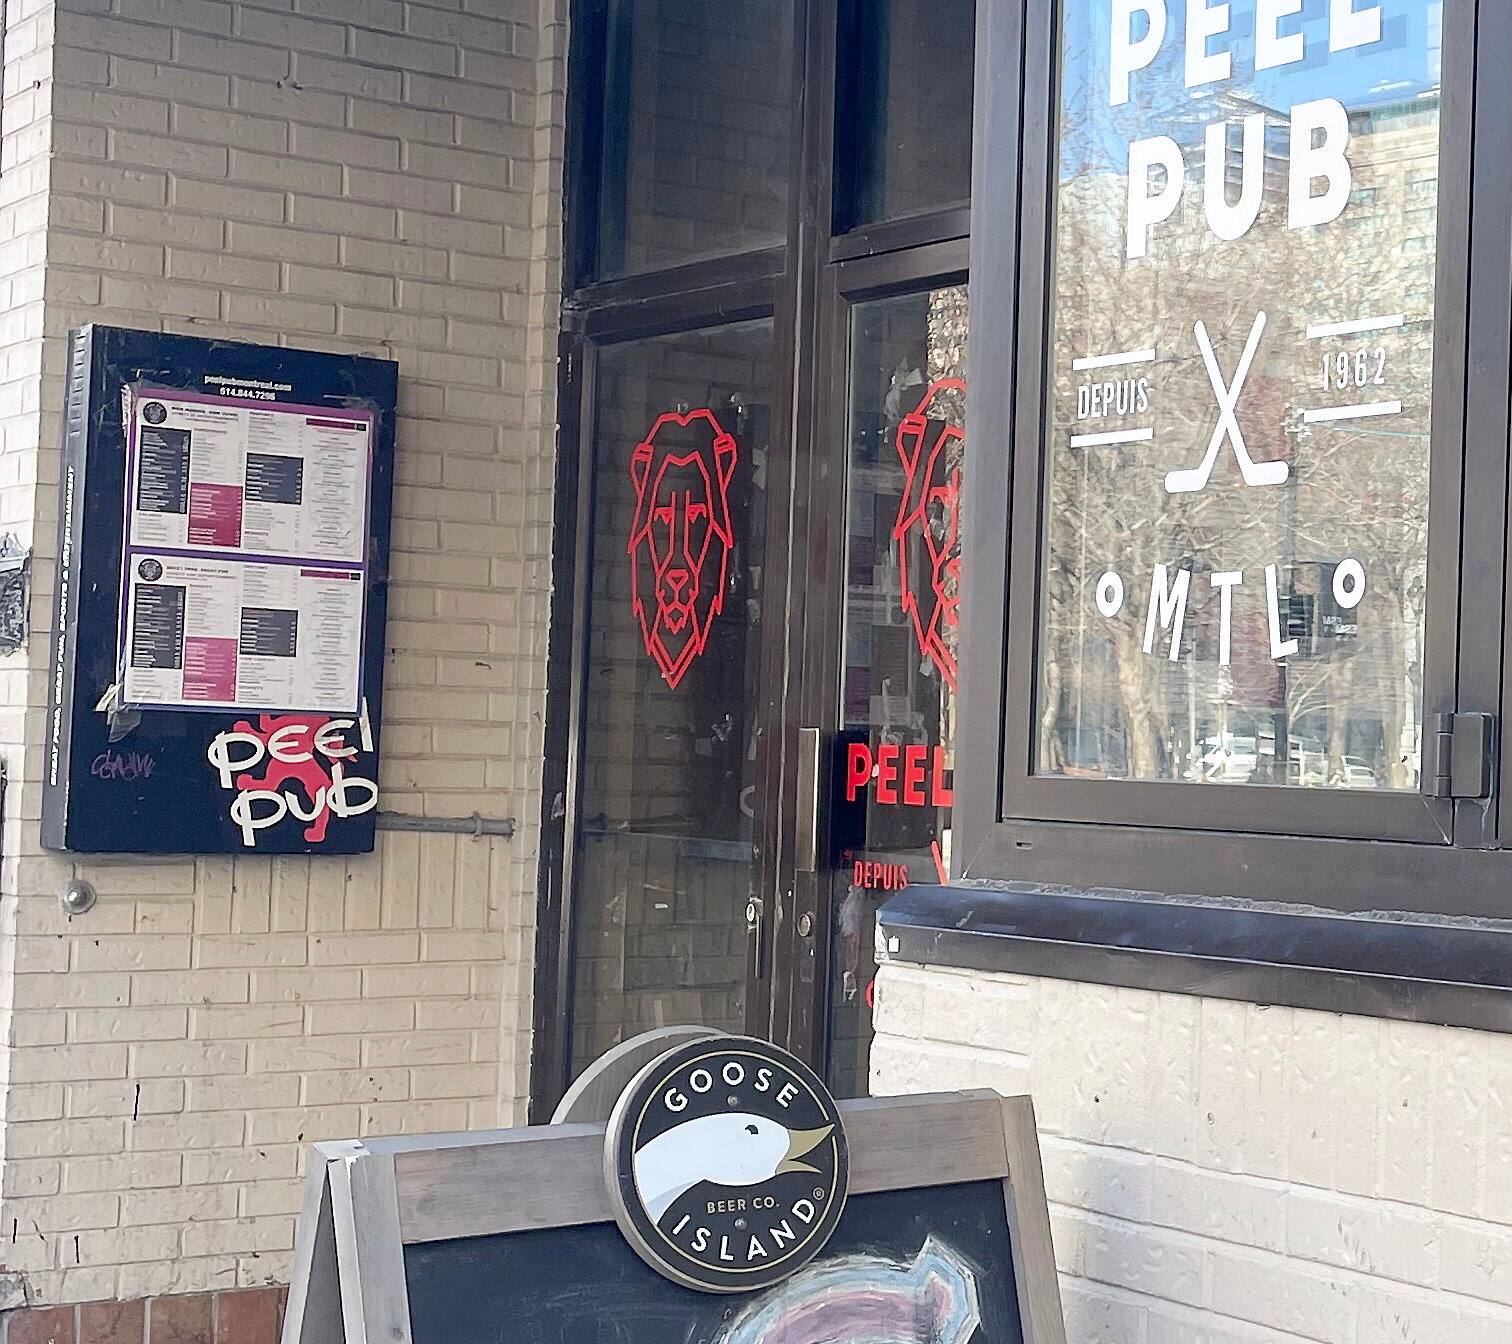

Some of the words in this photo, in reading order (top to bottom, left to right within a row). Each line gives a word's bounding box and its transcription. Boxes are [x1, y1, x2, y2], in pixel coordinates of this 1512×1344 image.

[1124, 97, 1352, 260] PUB
[1320, 347, 1386, 391] 1962
[1077, 377, 1150, 420] DEPUIS
[846, 742, 956, 807] PEEL
[853, 860, 910, 892] DEPUIS
[663, 1061, 799, 1112] GOOSE
[706, 1198, 747, 1214] BEER
[752, 1196, 780, 1210] CO.
[672, 1198, 816, 1261] ISLAND
